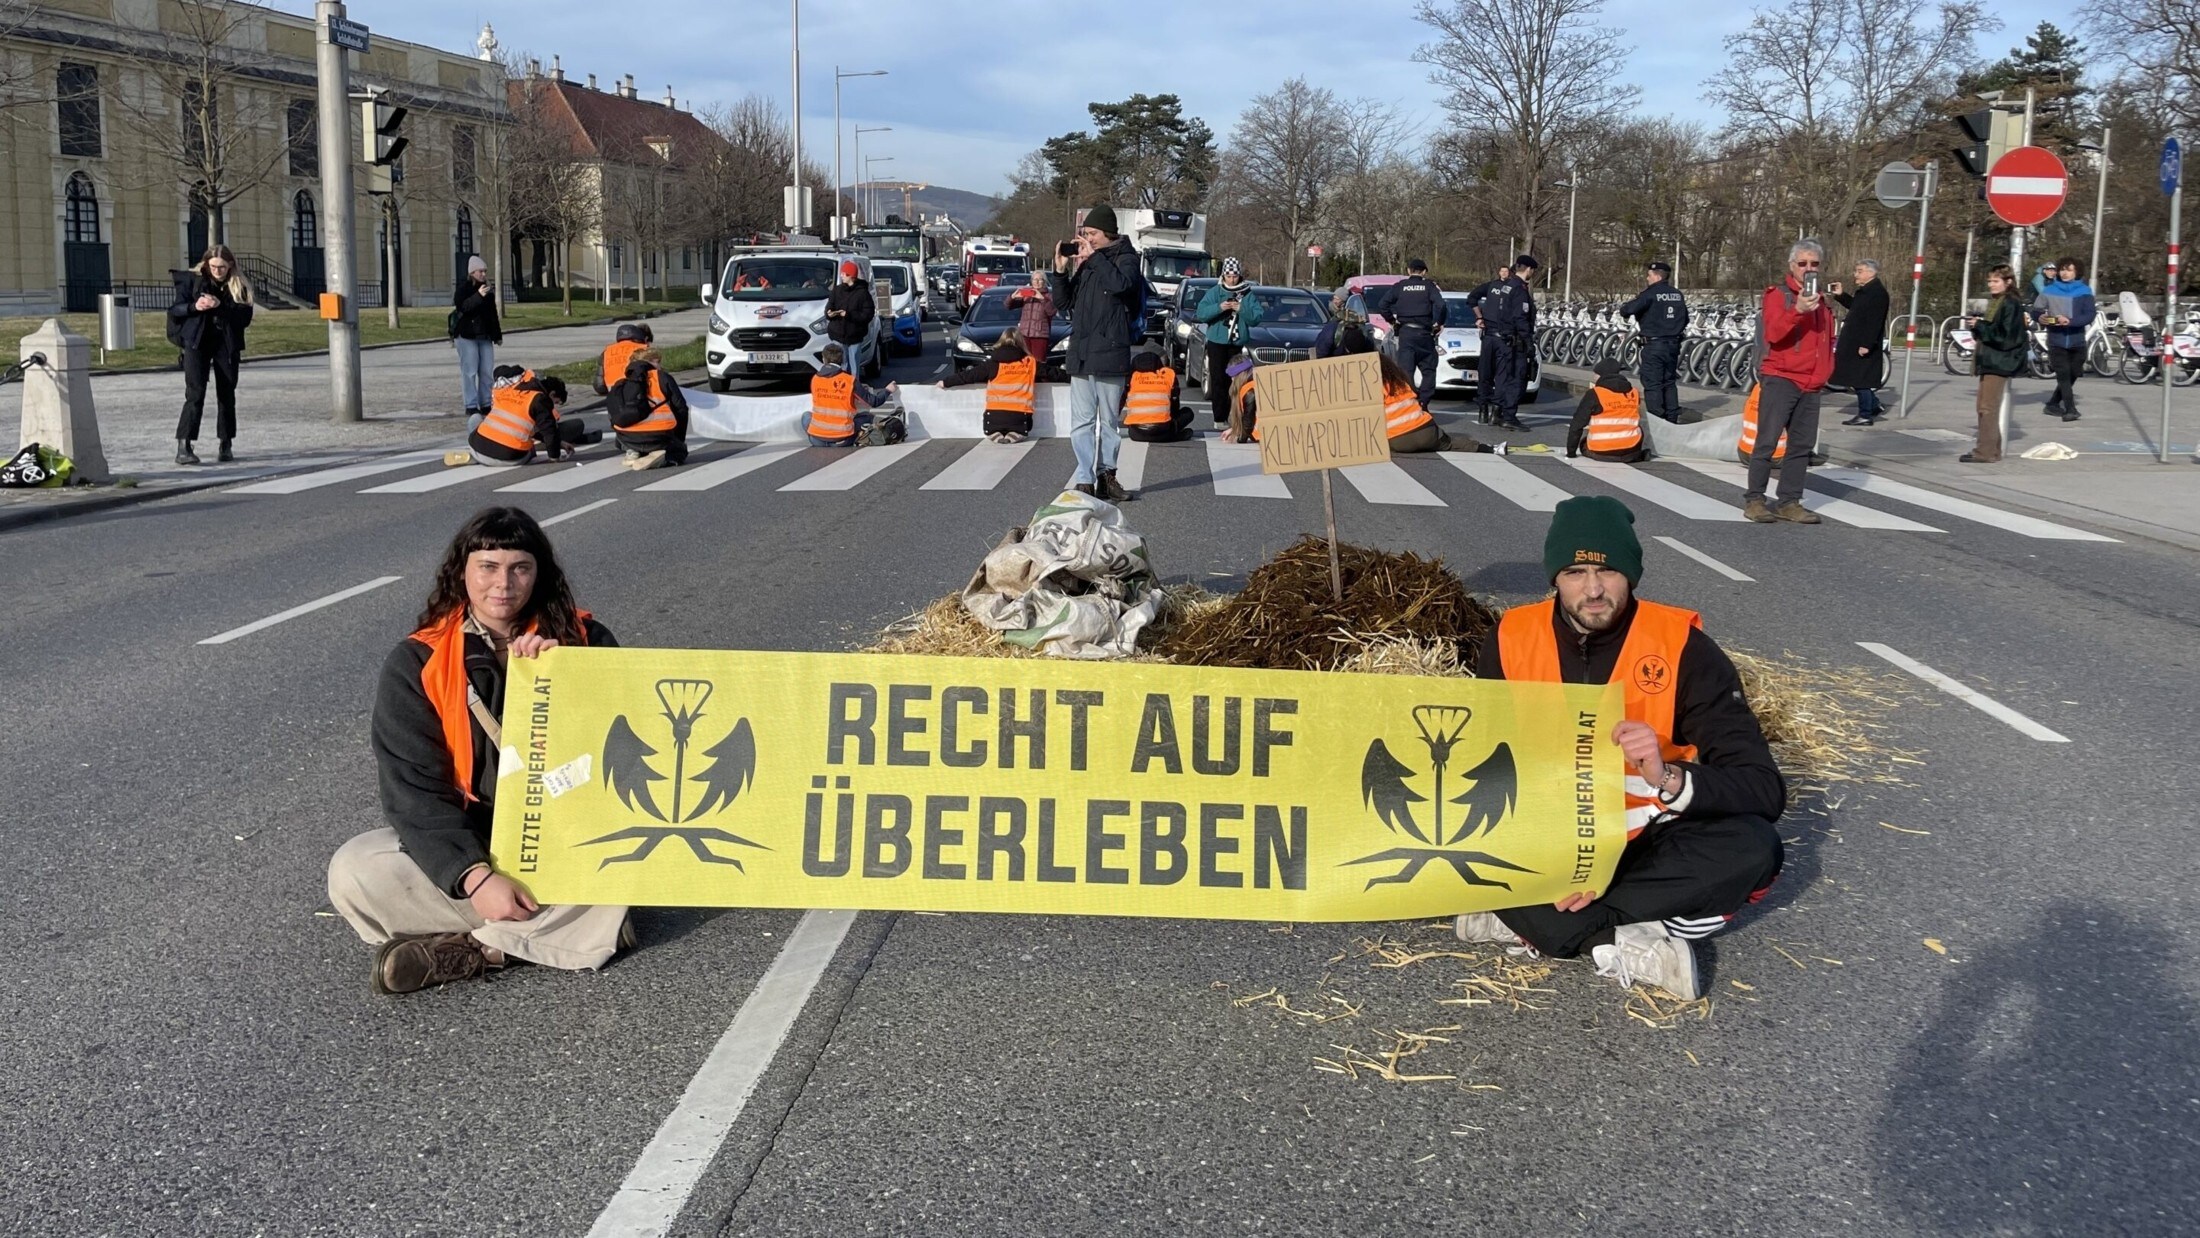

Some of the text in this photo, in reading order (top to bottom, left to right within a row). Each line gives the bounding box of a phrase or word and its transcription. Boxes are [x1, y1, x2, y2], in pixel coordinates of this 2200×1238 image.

[1656, 293, 1682, 302] POLIZEI
[1255, 355, 1380, 412] NEHAMMER'S
[519, 675, 552, 873] LETZTE GENERATION.AT
[827, 682, 1299, 778] RECHT AUF
[802, 774, 1308, 891] ÜBERLEBEN
[1570, 711, 1597, 885] LETZTE GENERATION.AT
